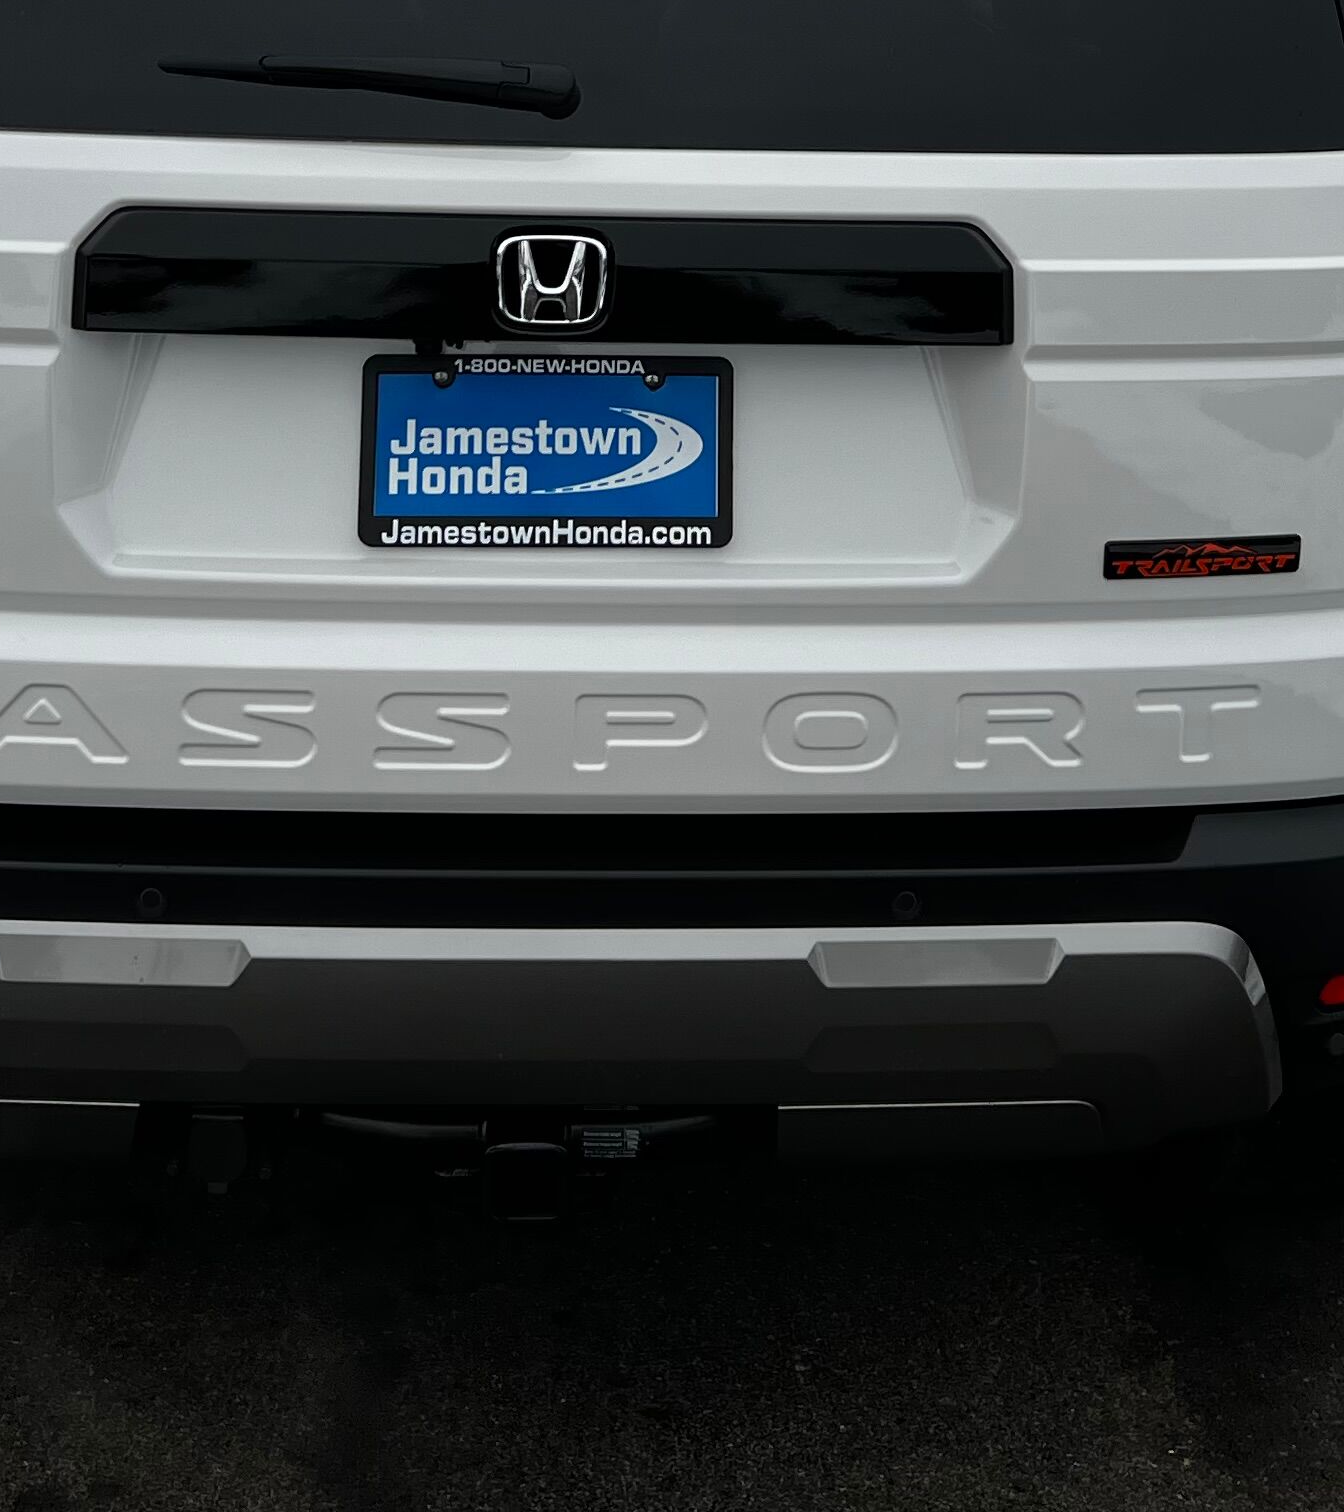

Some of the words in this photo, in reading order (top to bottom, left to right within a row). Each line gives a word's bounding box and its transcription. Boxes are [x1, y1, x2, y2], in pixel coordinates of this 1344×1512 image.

[453, 358, 646, 375] 1-800-NEW-HONDA
[389, 418, 642, 456] Jamestown
[387, 456, 529, 495] Honda
[380, 519, 712, 546] JamestownHonda.com
[1112, 554, 1297, 577] TRAILSPORT
